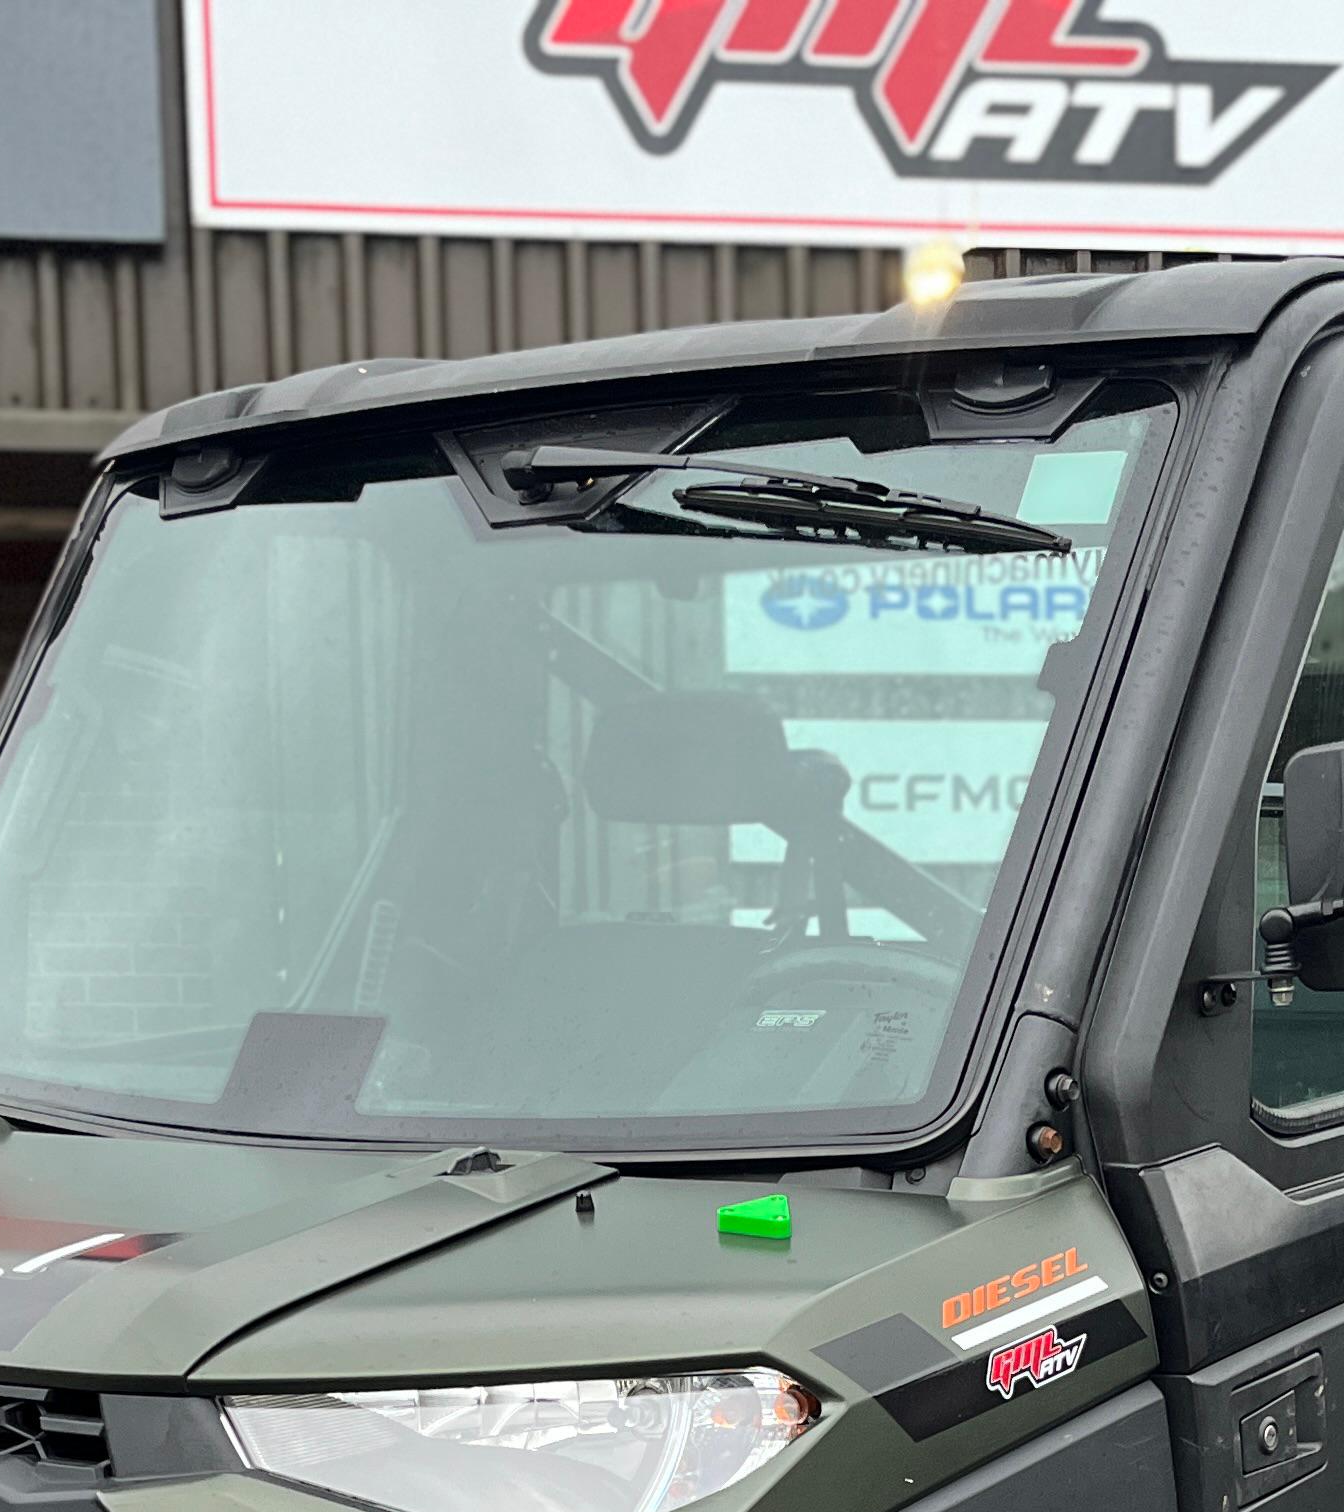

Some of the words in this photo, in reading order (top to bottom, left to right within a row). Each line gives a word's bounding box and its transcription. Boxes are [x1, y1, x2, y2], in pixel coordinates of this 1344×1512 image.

[928, 82, 1284, 167] ATV
[942, 1246, 1088, 1329] DIESEL
[1038, 1345, 1079, 1381] ATV
